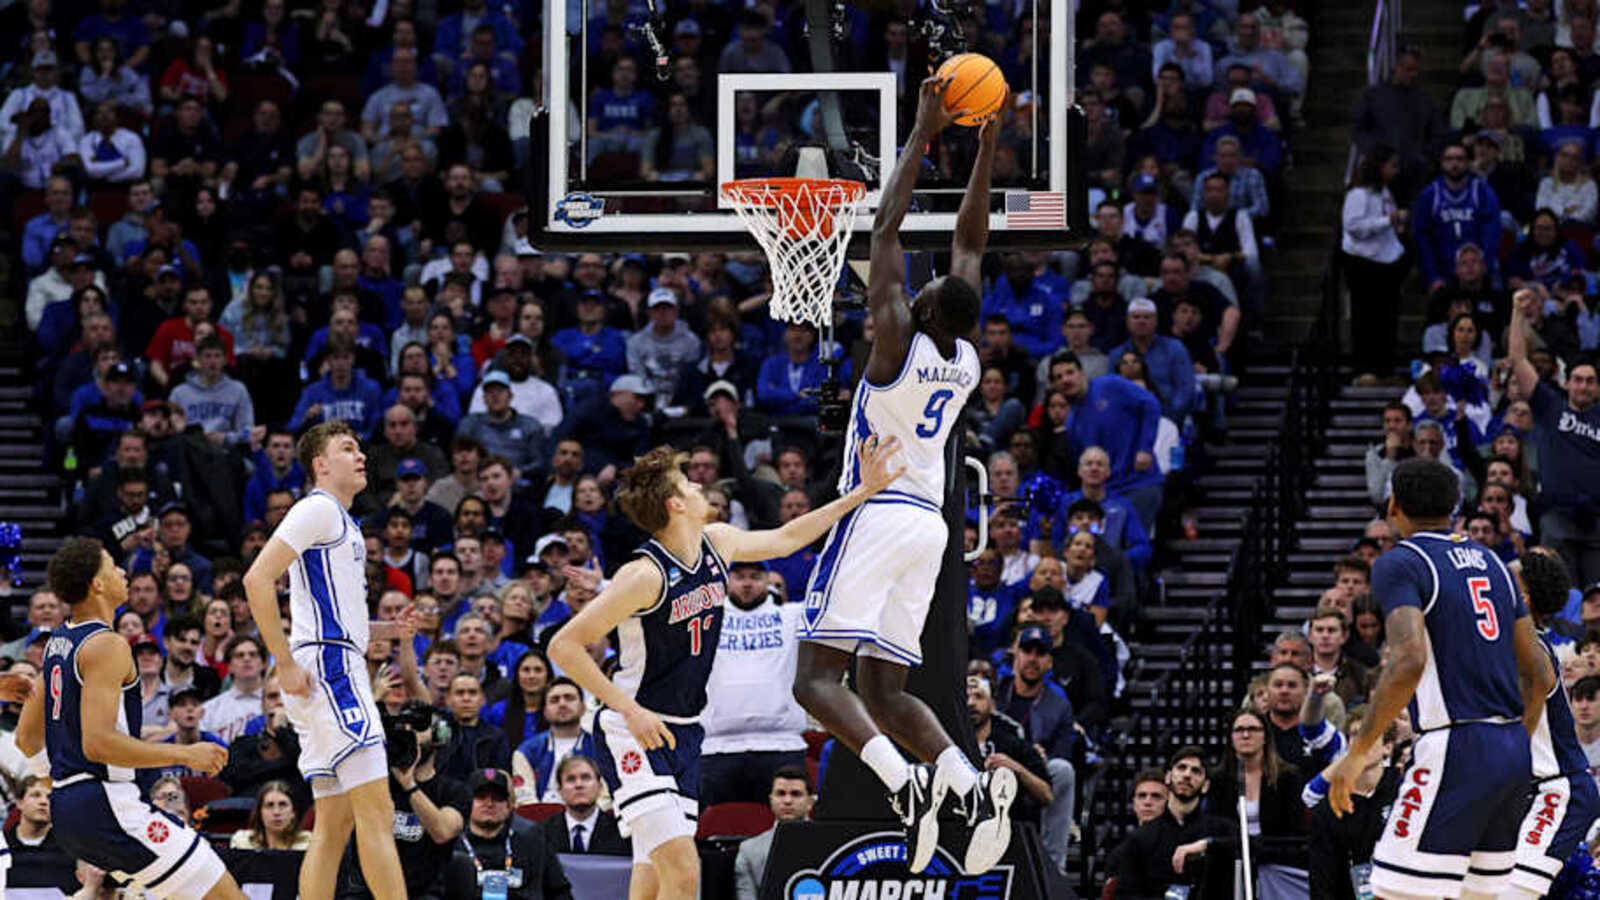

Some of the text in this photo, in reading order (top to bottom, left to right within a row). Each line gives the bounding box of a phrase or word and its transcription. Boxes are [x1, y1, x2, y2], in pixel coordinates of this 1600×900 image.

[916, 389, 954, 438] 9
[1446, 546, 1488, 571] LEWIS
[1467, 576, 1500, 641] 5
[1395, 767, 1431, 838] CATS
[1526, 793, 1561, 845] CATS
[857, 845, 900, 865] SWEET
[828, 880, 947, 900] MARCH
